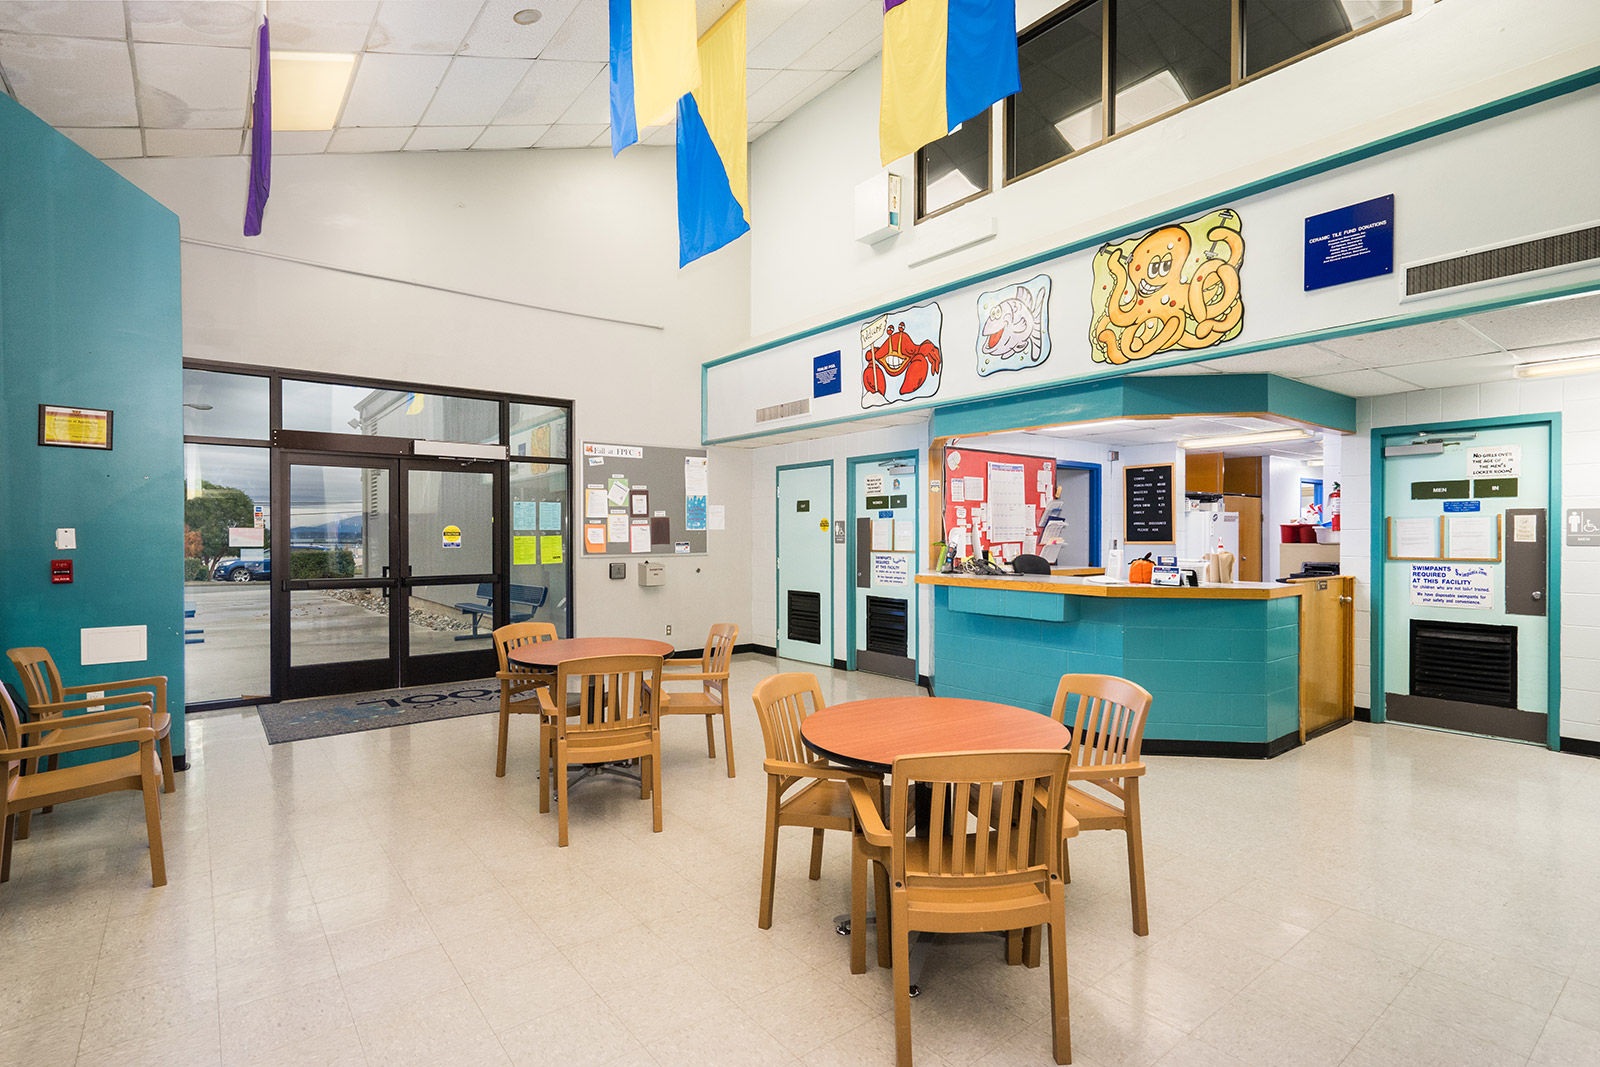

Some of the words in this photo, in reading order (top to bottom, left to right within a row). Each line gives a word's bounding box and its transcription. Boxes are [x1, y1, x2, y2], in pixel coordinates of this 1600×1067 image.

[1309, 235, 1330, 244] CERAMIC
[1358, 220, 1387, 231] DONATIONS
[356, 689, 500, 707] OOL
